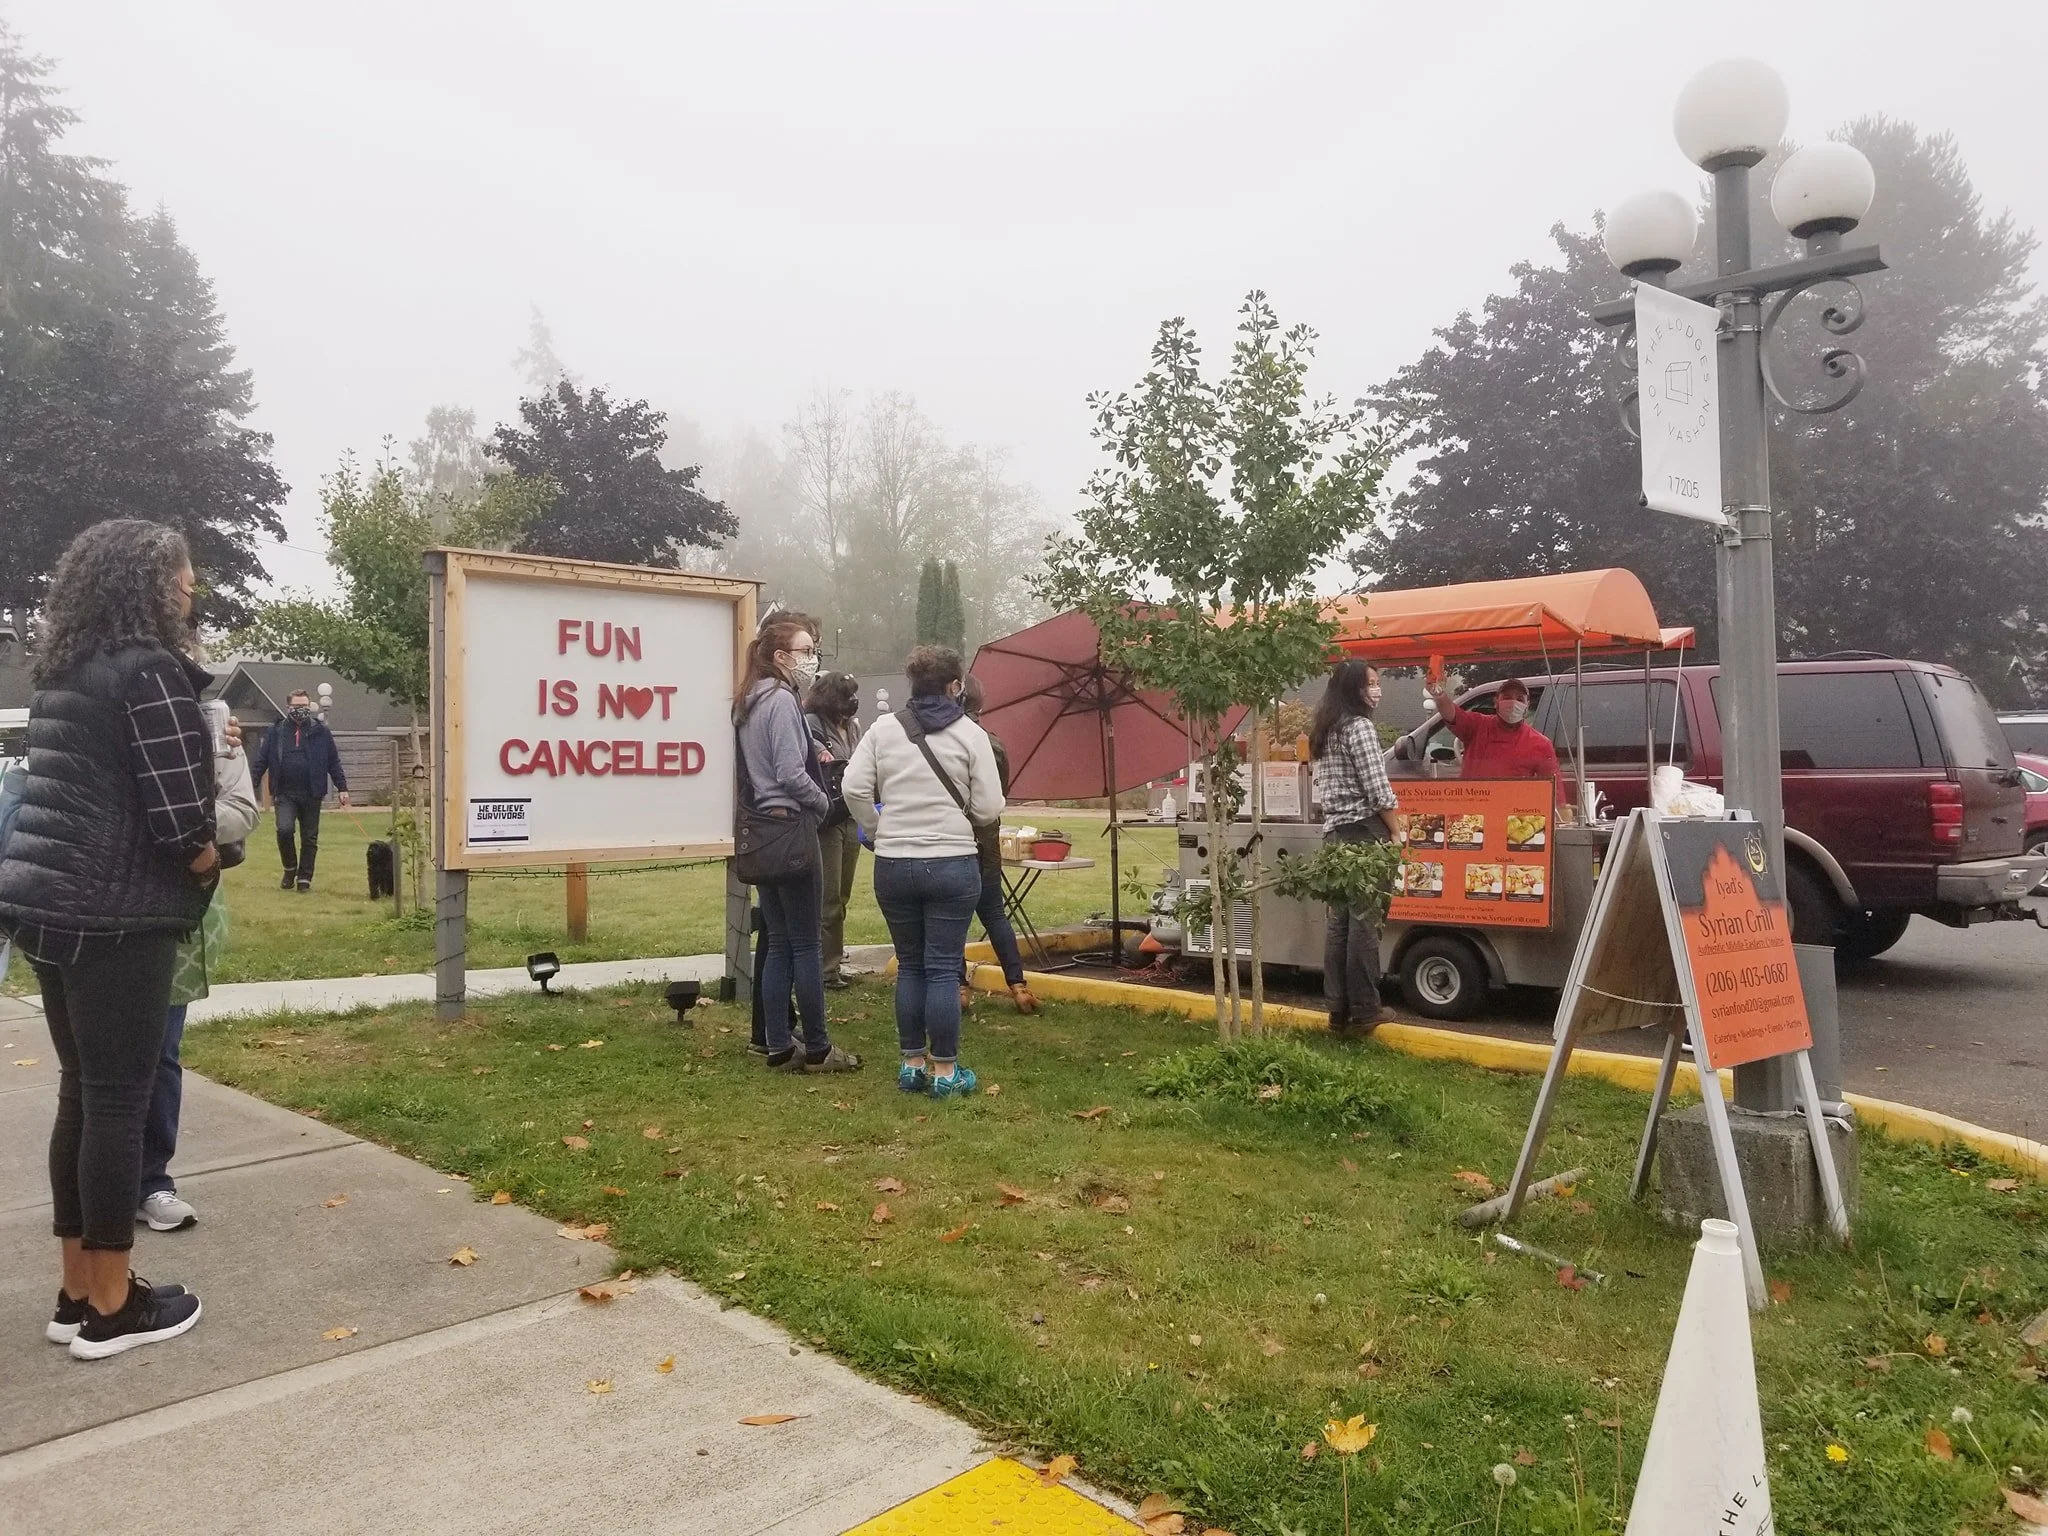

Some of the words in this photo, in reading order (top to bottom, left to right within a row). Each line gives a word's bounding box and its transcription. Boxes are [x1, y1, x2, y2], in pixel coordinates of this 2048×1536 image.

[1645, 325, 1663, 365] THE
[1668, 318, 1710, 382] LODGES
[1648, 384, 1662, 417] ON
[1667, 400, 1710, 443] VASHON
[1668, 475, 1700, 499] 17205
[558, 618, 642, 662] FUN
[538, 679, 579, 717] IS
[500, 738, 706, 777] CANCELED
[1394, 787, 1412, 797] ad's
[1414, 787, 1442, 798] Syrian
[1444, 787, 1463, 796] Grill
[1465, 788, 1491, 796] Menu
[477, 812, 525, 820] SURVIVORS!
[478, 804, 490, 813] WE
[492, 804, 524, 813] BELIEVE
[1715, 877, 1744, 899] Iyad's
[1698, 912, 1745, 943] Syrian
[1746, 908, 1775, 933] Grill
[1706, 970, 1738, 997] (206)
[1740, 962, 1789, 988] 403-0687
[1711, 995, 1796, 1018] syrianfood20@gmail.com
[1714, 1032, 1738, 1045] Catering
